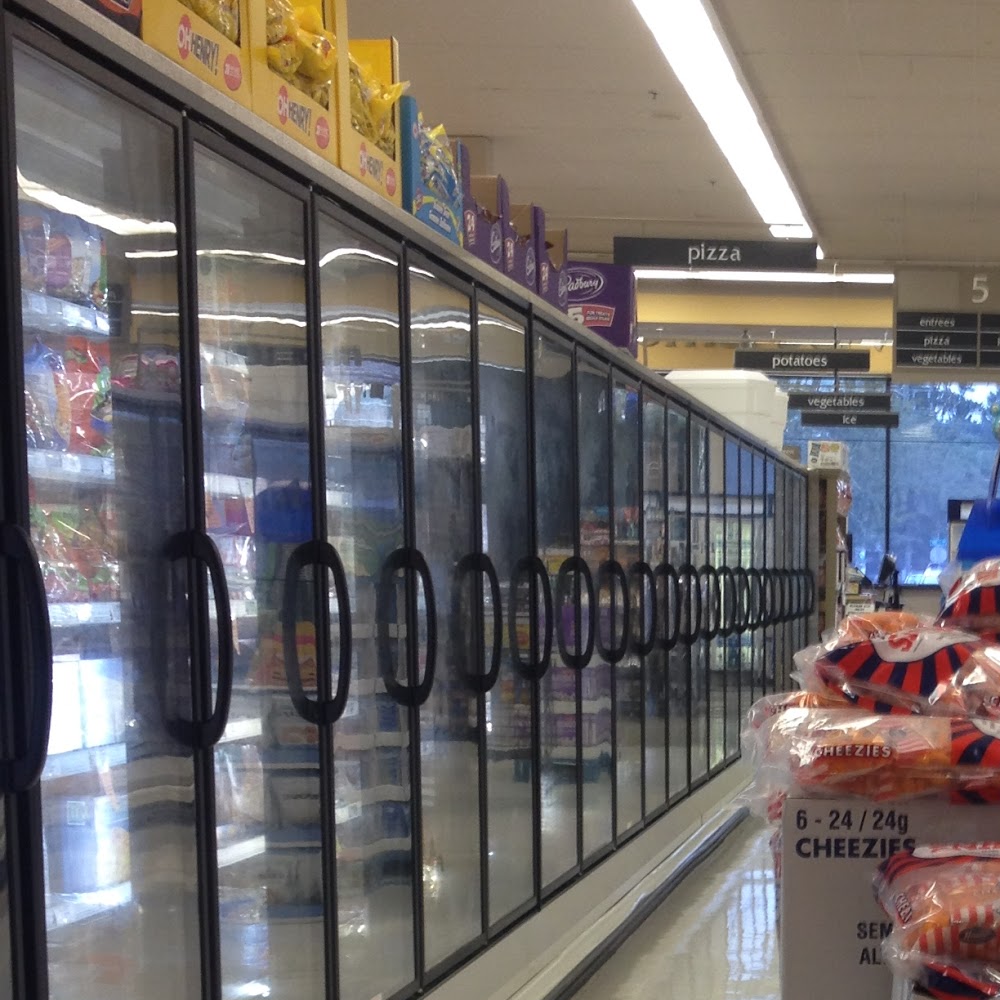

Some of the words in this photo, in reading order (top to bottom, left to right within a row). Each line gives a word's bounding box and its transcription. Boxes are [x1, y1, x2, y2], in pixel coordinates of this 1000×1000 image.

[177, 27, 192, 51] OH
[191, 34, 219, 76] HENRY!
[278, 92, 288, 113] OH
[688, 243, 742, 264] pizza
[971, 275, 989, 303] 5
[919, 317, 956, 328] entrees
[924, 335, 950, 347] pizza
[772, 354, 828, 368] potatoes
[912, 354, 962, 365] vegetables
[807, 397, 864, 409] vegetables
[842, 415, 857, 425] ice
[815, 744, 891, 758] CHEEZIES
[796, 810, 807, 830] 6
[829, 811, 853, 830] 24
[873, 811, 908, 834] 24g
[795, 838, 916, 858] CHEEZIES
